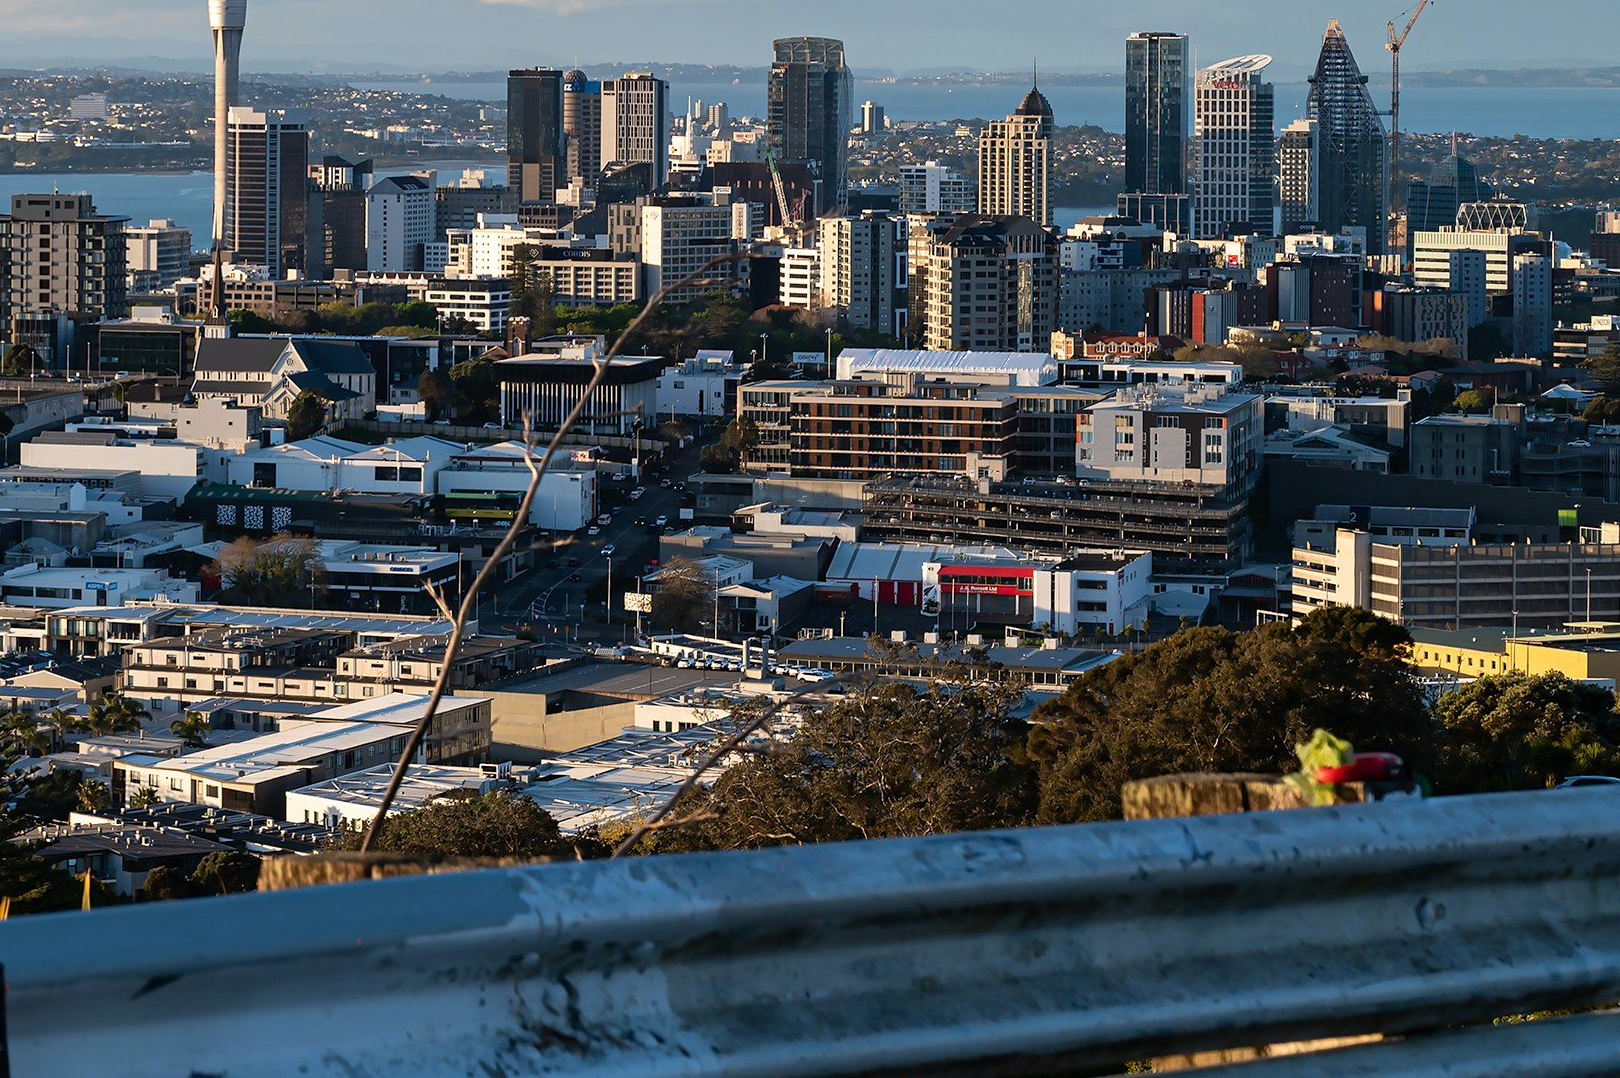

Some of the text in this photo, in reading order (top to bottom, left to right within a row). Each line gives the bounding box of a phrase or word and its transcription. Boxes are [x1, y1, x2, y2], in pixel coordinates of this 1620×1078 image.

[1212, 81, 1241, 90] vero
[562, 250, 592, 258] CORDIS
[1350, 512, 1357, 522] 2
